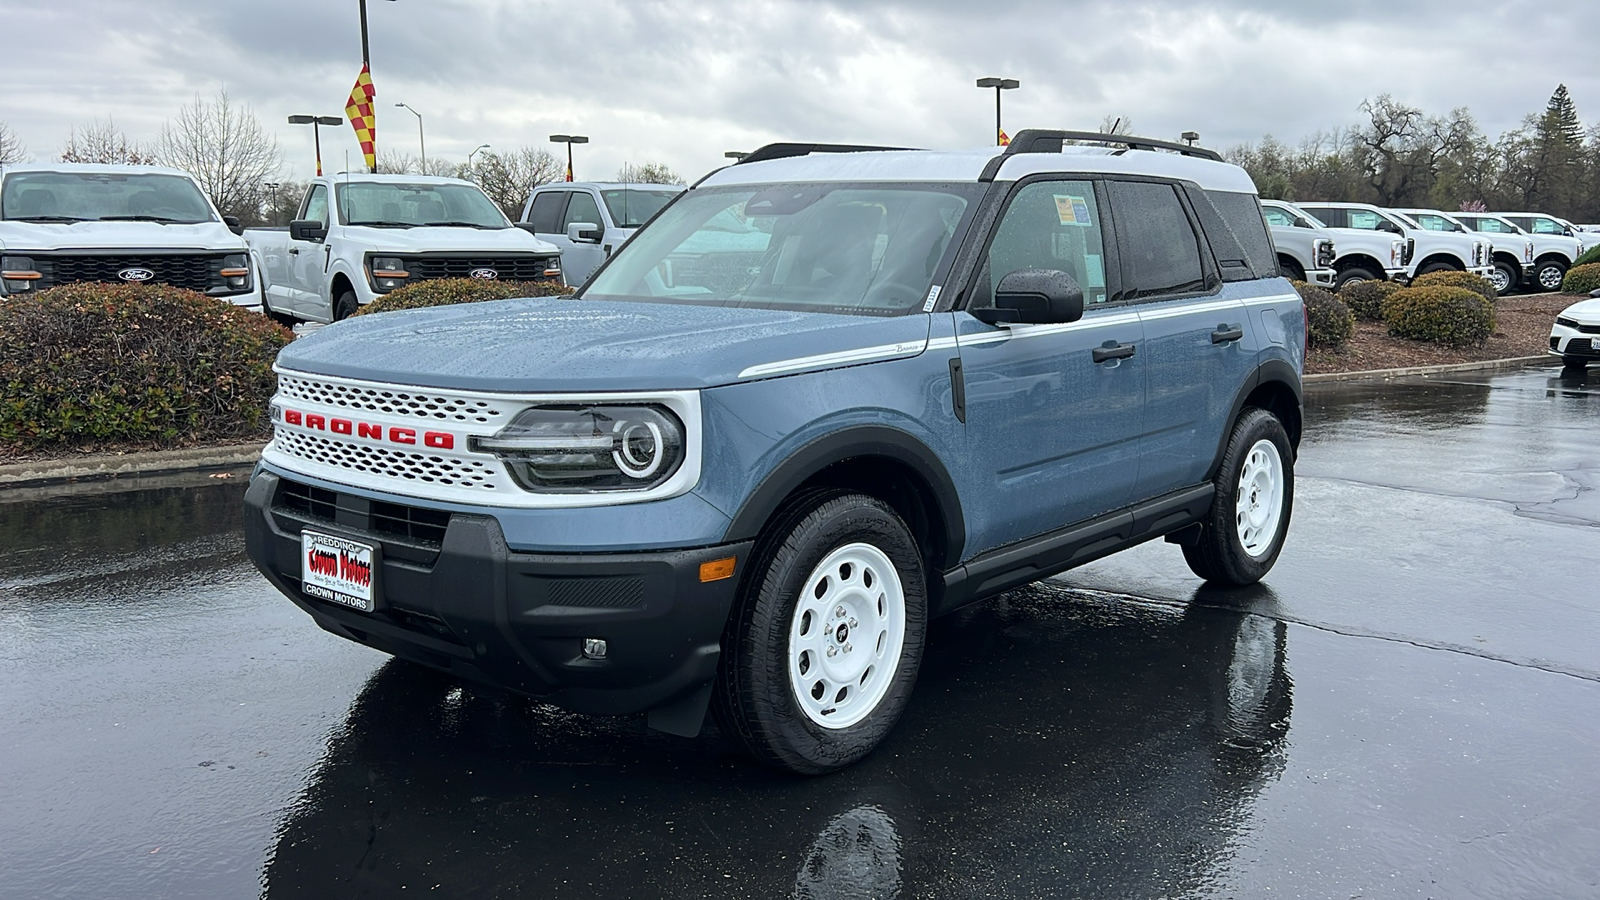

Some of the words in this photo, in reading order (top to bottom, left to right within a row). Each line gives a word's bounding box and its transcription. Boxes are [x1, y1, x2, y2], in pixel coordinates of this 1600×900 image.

[125, 270, 148, 279] Ford
[285, 409, 454, 449] BRONCO
[318, 537, 354, 551] REDDING
[308, 547, 337, 577] Crown
[340, 549, 370, 587] Motors
[306, 585, 333, 599] CROWN
[335, 593, 366, 608] MOTORS
